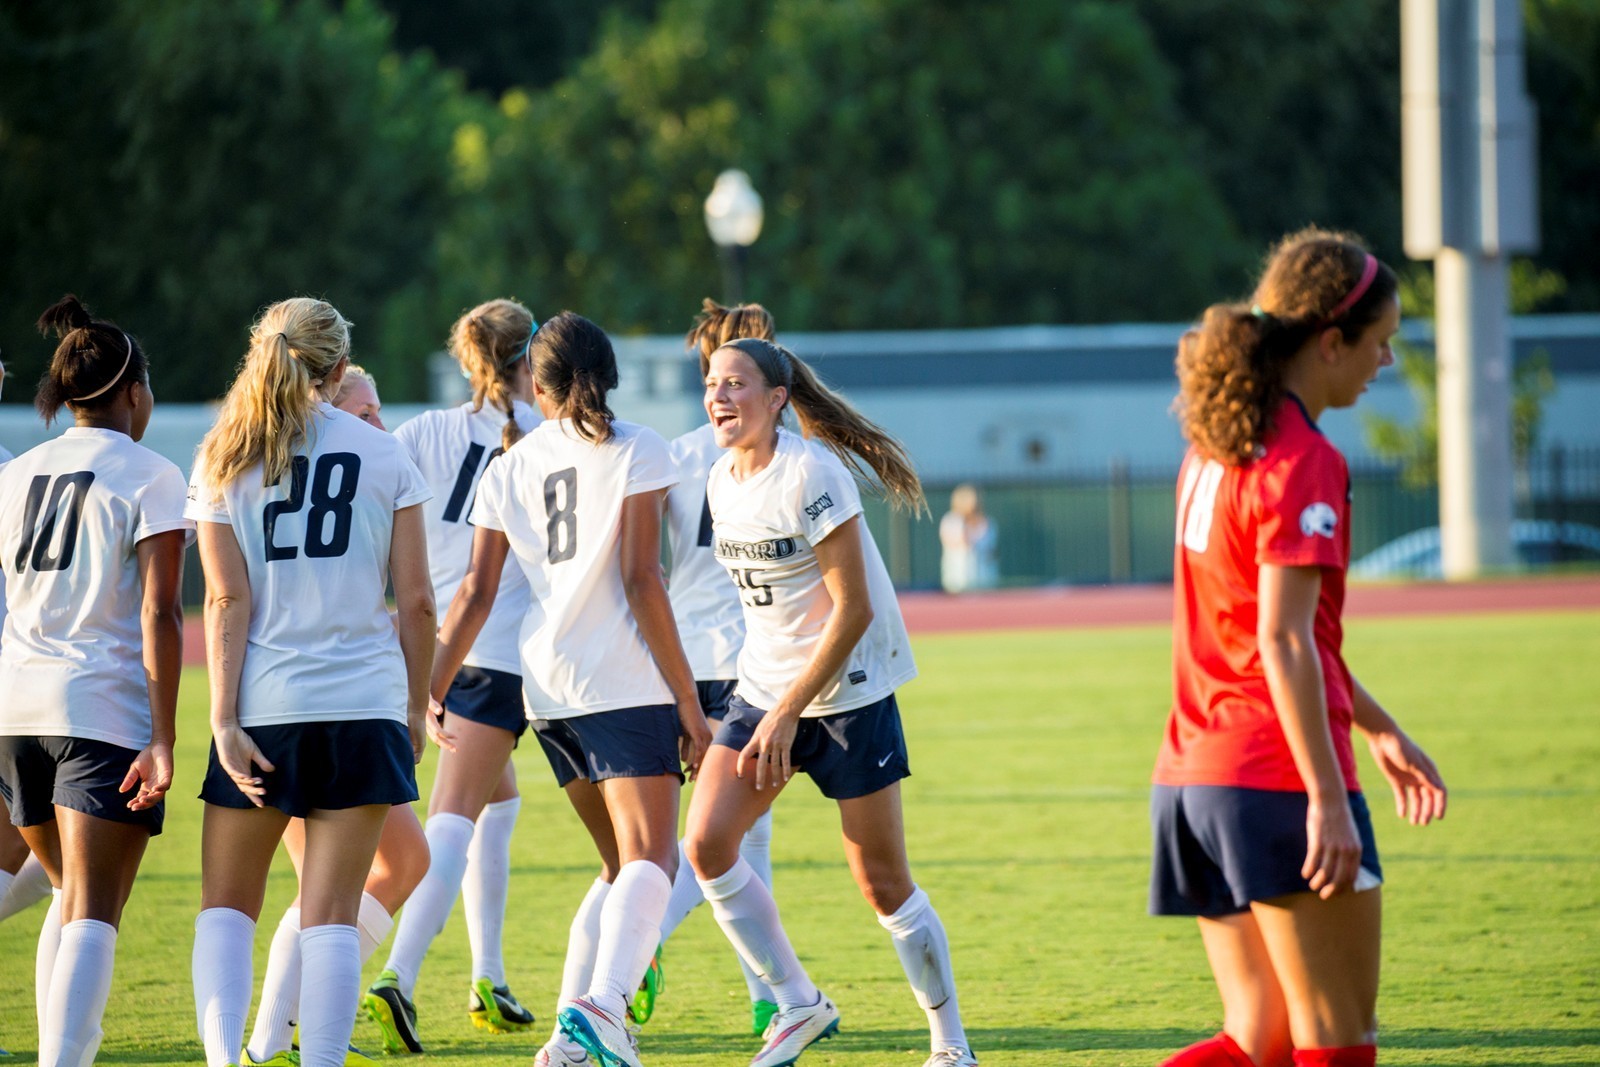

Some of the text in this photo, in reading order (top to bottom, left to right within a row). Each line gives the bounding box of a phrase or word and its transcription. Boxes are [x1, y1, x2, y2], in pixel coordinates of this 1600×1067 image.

[15, 470, 95, 574] 10
[263, 451, 361, 563] 28
[441, 441, 503, 526] 1
[543, 466, 577, 565] 8
[804, 492, 834, 521] SOCON
